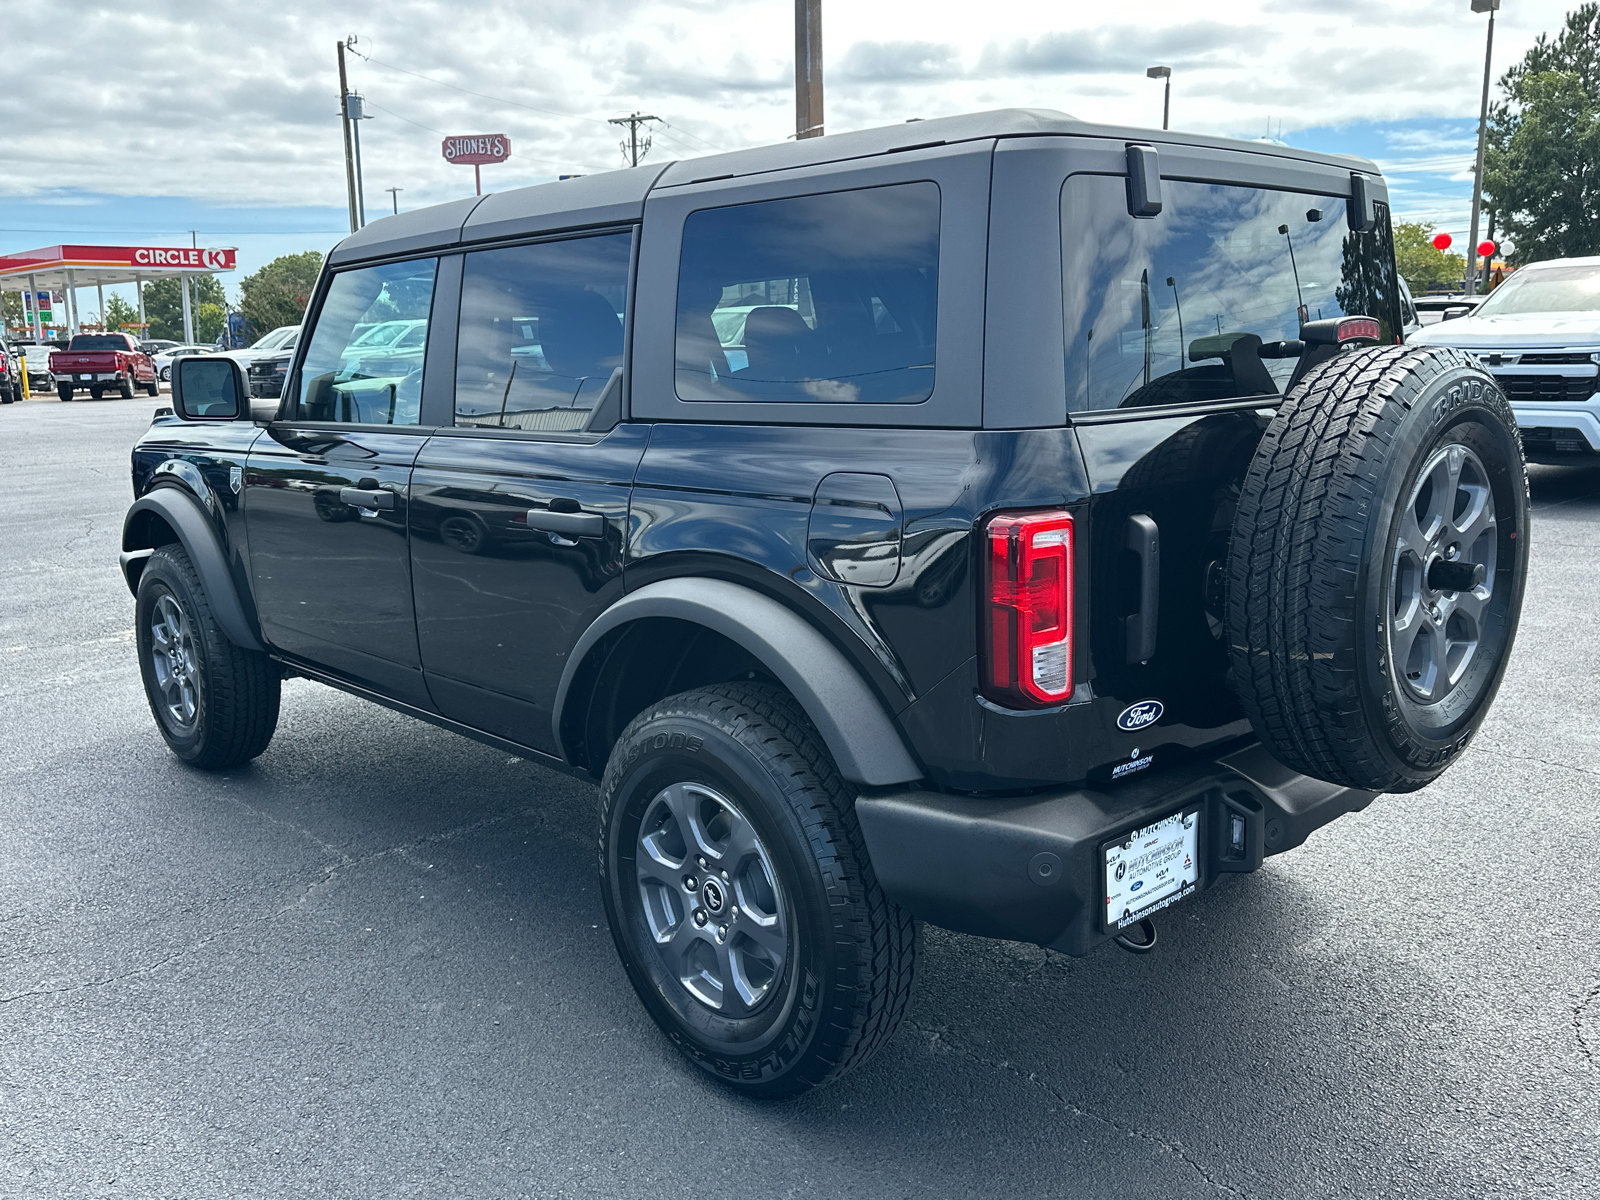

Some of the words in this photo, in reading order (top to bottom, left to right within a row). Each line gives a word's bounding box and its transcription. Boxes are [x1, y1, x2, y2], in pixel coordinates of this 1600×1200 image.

[445, 136, 504, 158] SHONEY'S
[135, 249, 199, 264] CIRCLE
[206, 250, 225, 269] K
[1127, 705, 1156, 727] Ford
[1112, 755, 1153, 775] HUTCHINSON
[1140, 812, 1183, 838] HUTCHINSON
[1128, 836, 1185, 873] HUTCHINSON
[1129, 858, 1162, 881] AUTOMOTIVE
[1163, 850, 1182, 865] GROUP
[1117, 885, 1195, 929] Hutchinsonautogroup.com
